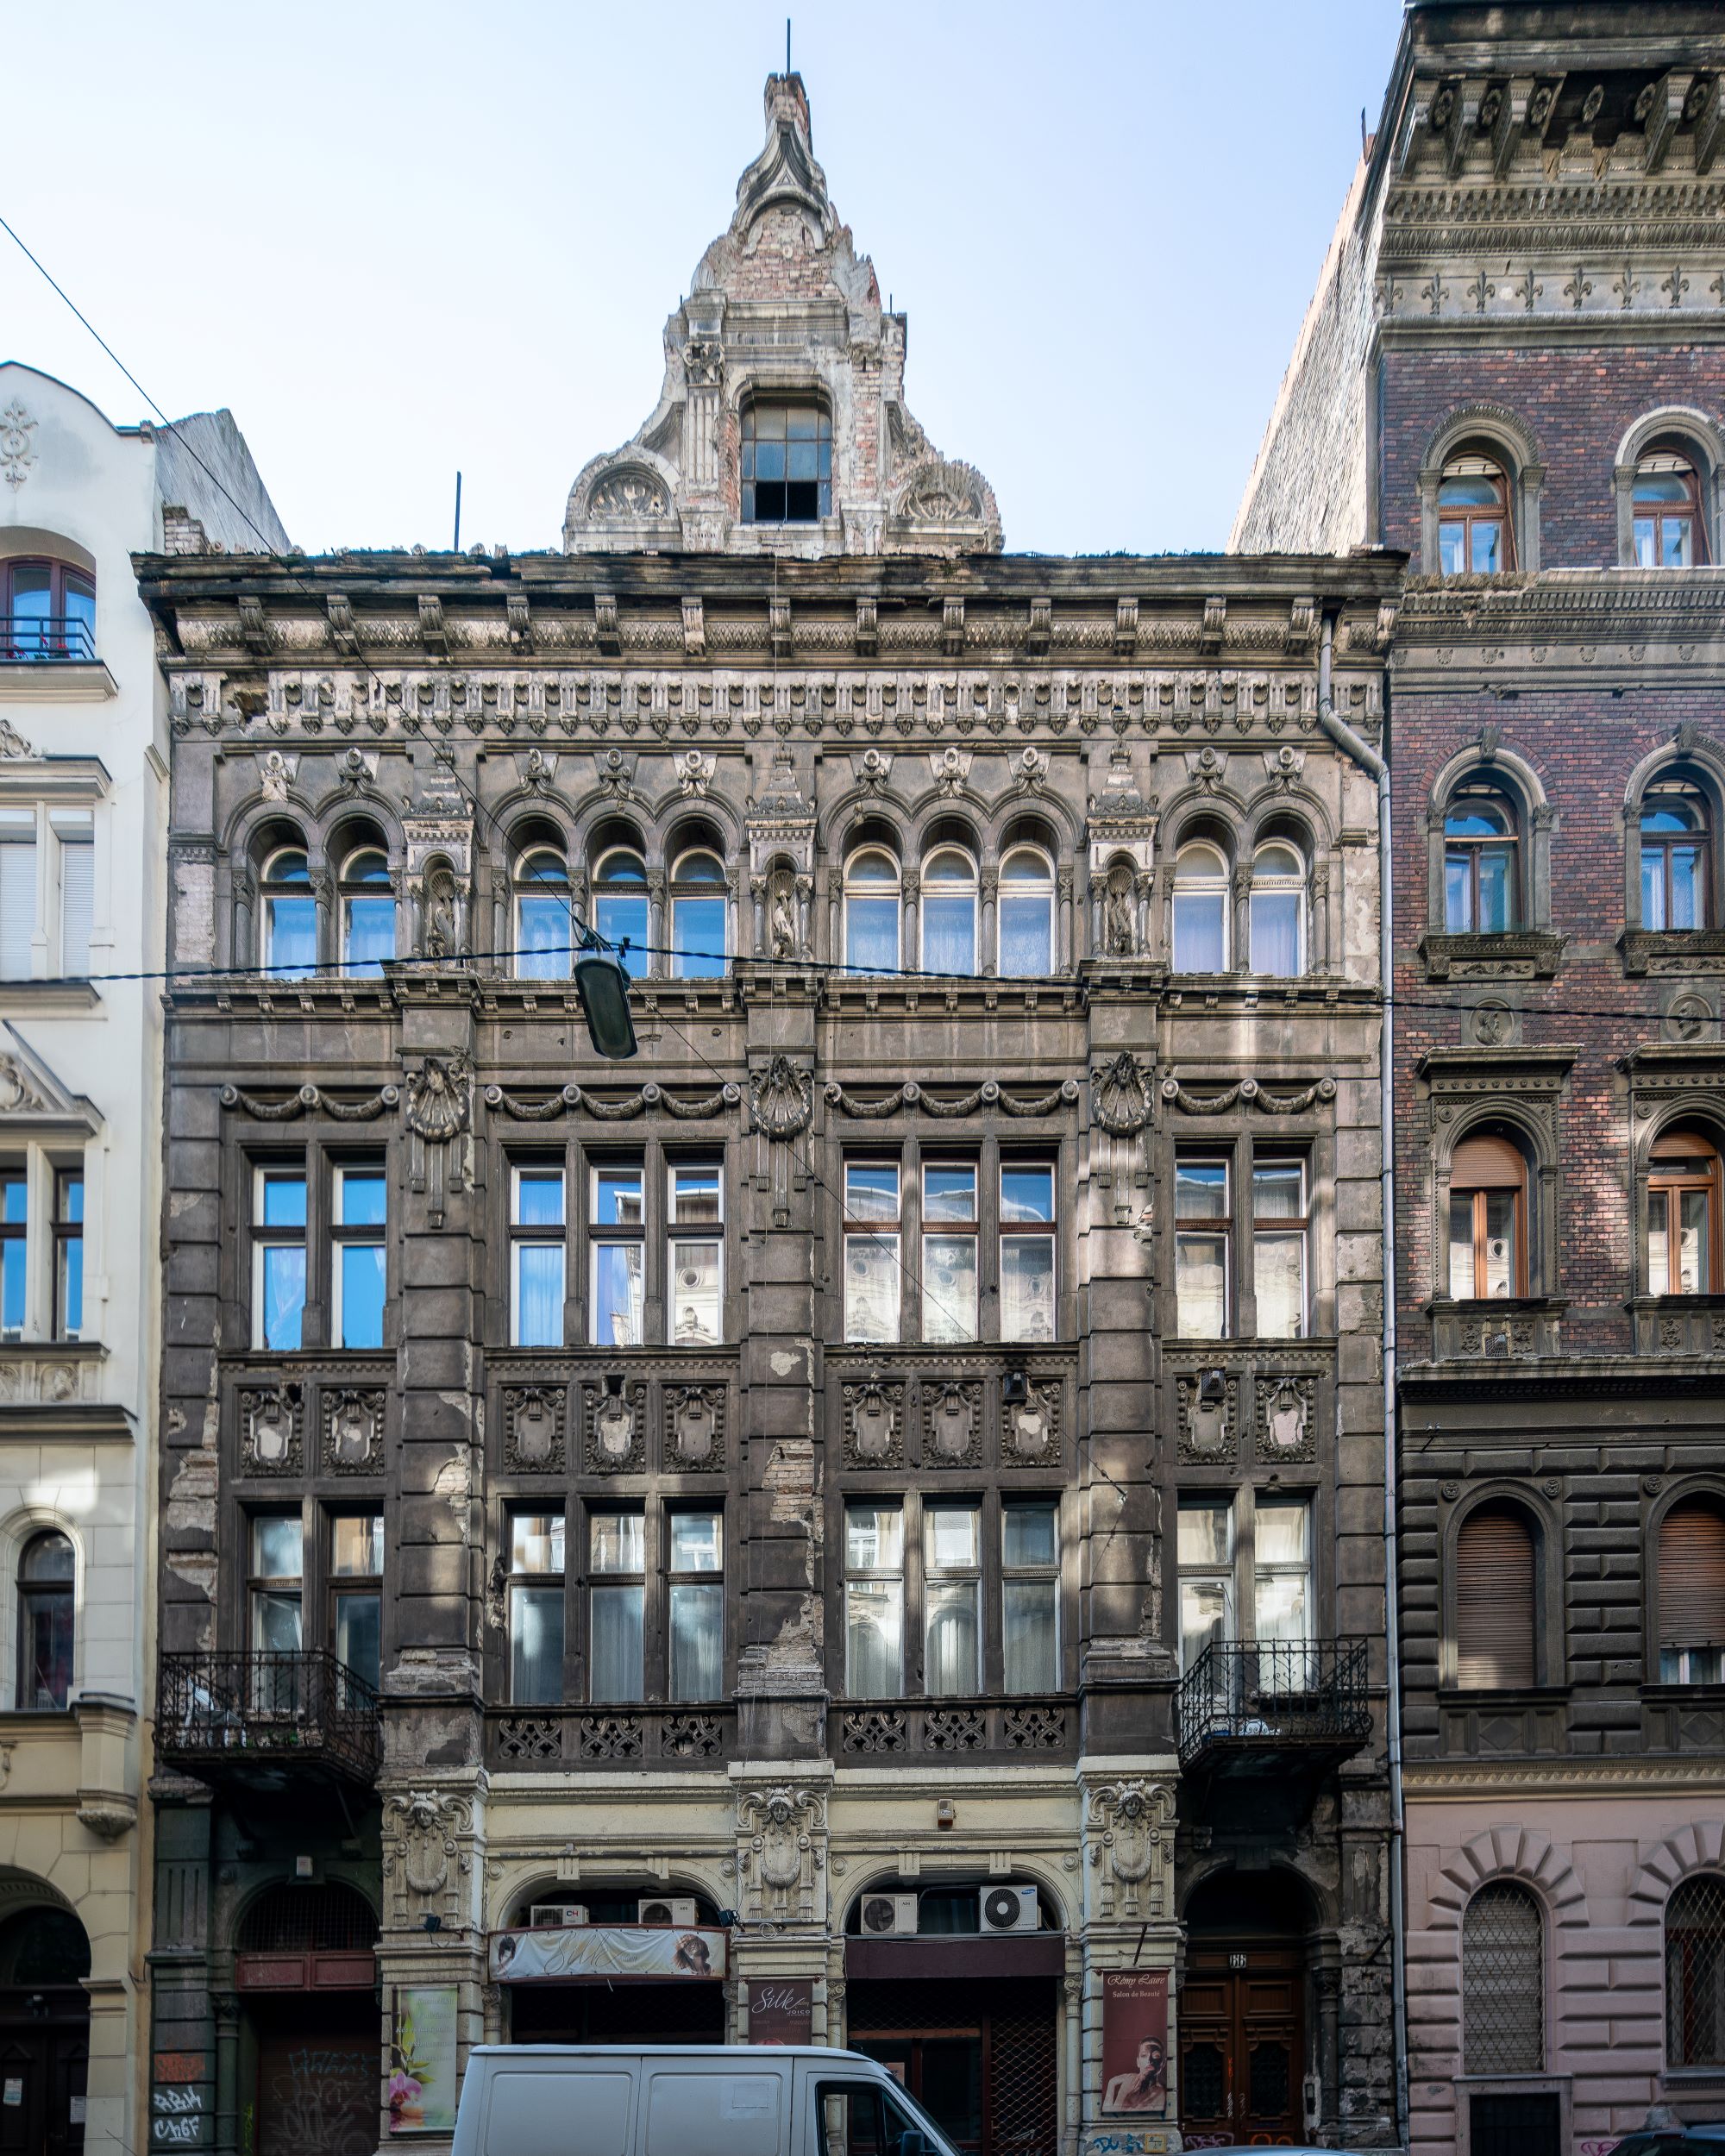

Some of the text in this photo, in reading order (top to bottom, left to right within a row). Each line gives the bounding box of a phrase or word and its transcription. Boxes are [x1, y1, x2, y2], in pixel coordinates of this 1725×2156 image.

[1107, 1974, 1165, 1988] Rémy Laure
[751, 1986, 806, 2013] Silk
